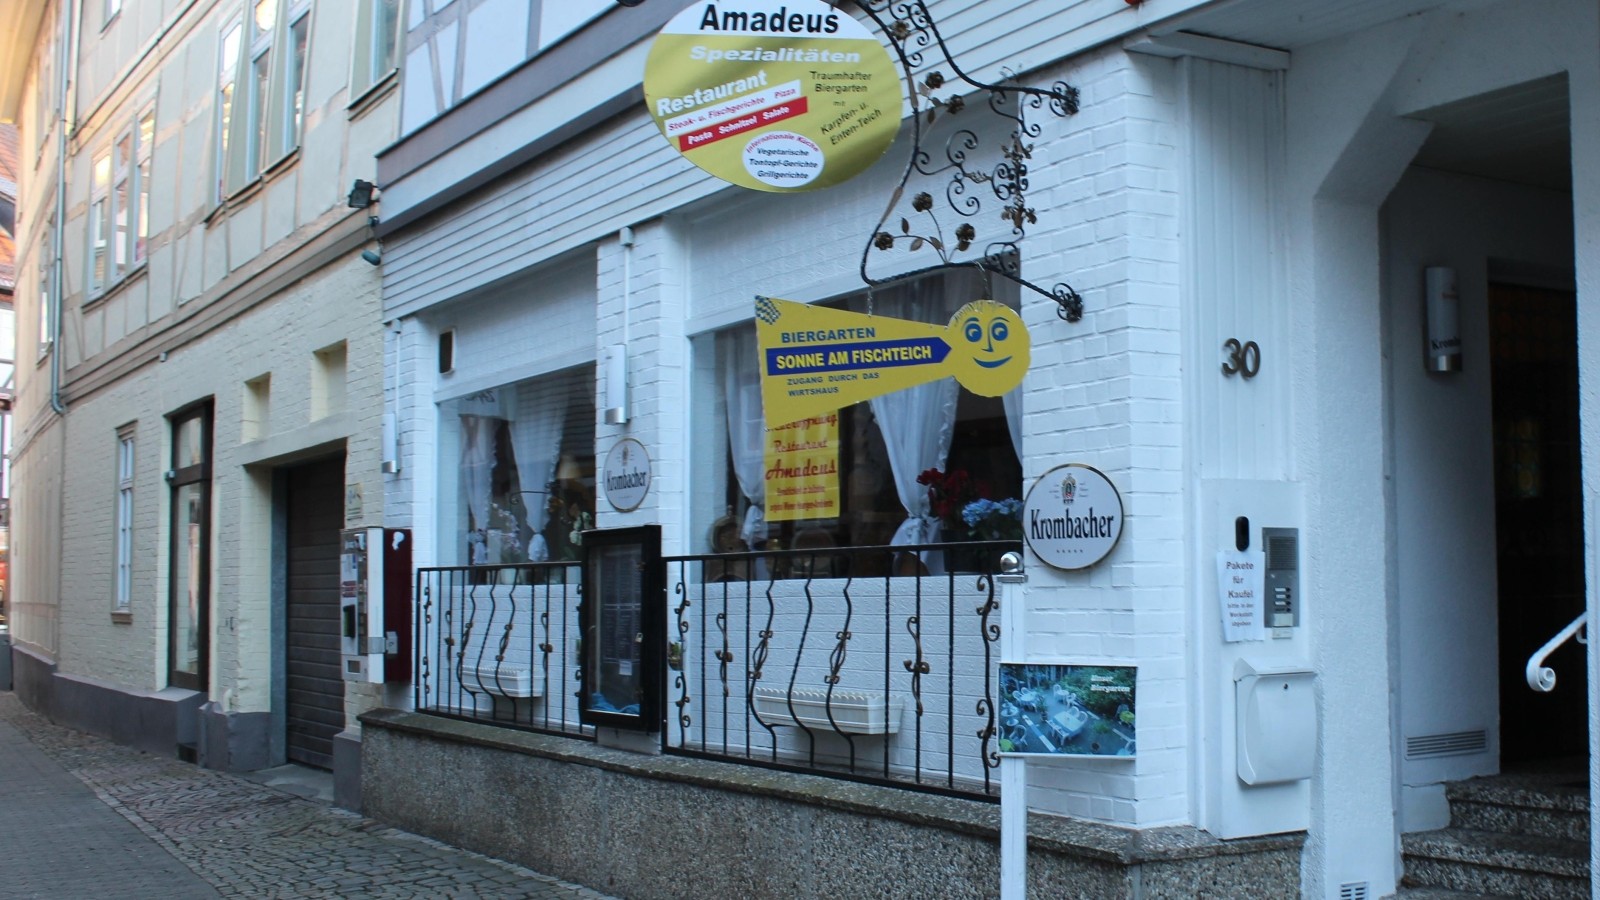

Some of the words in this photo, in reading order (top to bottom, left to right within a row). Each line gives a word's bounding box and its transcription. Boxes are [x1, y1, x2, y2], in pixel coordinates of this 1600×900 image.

[700, 4, 839, 34] Amadeus
[690, 46, 861, 64] Spezialitäten
[810, 71, 872, 81] Traumhafter
[656, 70, 768, 117] Restaurant
[815, 84, 868, 94] Biergarten
[668, 118, 697, 132] Steak-
[708, 96, 766, 119] Fischgerichte
[774, 87, 797, 99] Pizza
[687, 131, 714, 145] Pasta
[718, 115, 758, 135] Schnitzel
[762, 106, 790, 120] Salate
[821, 109, 858, 135] Karpfen-
[830, 109, 882, 145] Enten-Teich
[757, 148, 810, 156] Vegetarische
[749, 158, 819, 168] Tontopf-Gerichte
[757, 170, 809, 179] Grillgerichte
[781, 327, 876, 344] BIERGARTEN
[776, 353, 825, 369] SONNE
[828, 350, 849, 365] AM
[852, 346, 932, 363] FISCHTEICH
[1222, 338, 1261, 379] 30
[787, 376, 823, 386] ZUGANG
[828, 374, 858, 382] DURCH
[862, 372, 880, 380] DAS
[788, 387, 839, 397] WIRTSHAUS
[774, 440, 828, 453] Restaurant
[765, 459, 836, 480] Amadeus
[607, 467, 646, 491] Krombacher
[1030, 506, 1115, 540] Krombacher
[1226, 562, 1254, 570] Pakete
[1233, 576, 1244, 584] für
[1091, 684, 1130, 693] Biergarten
